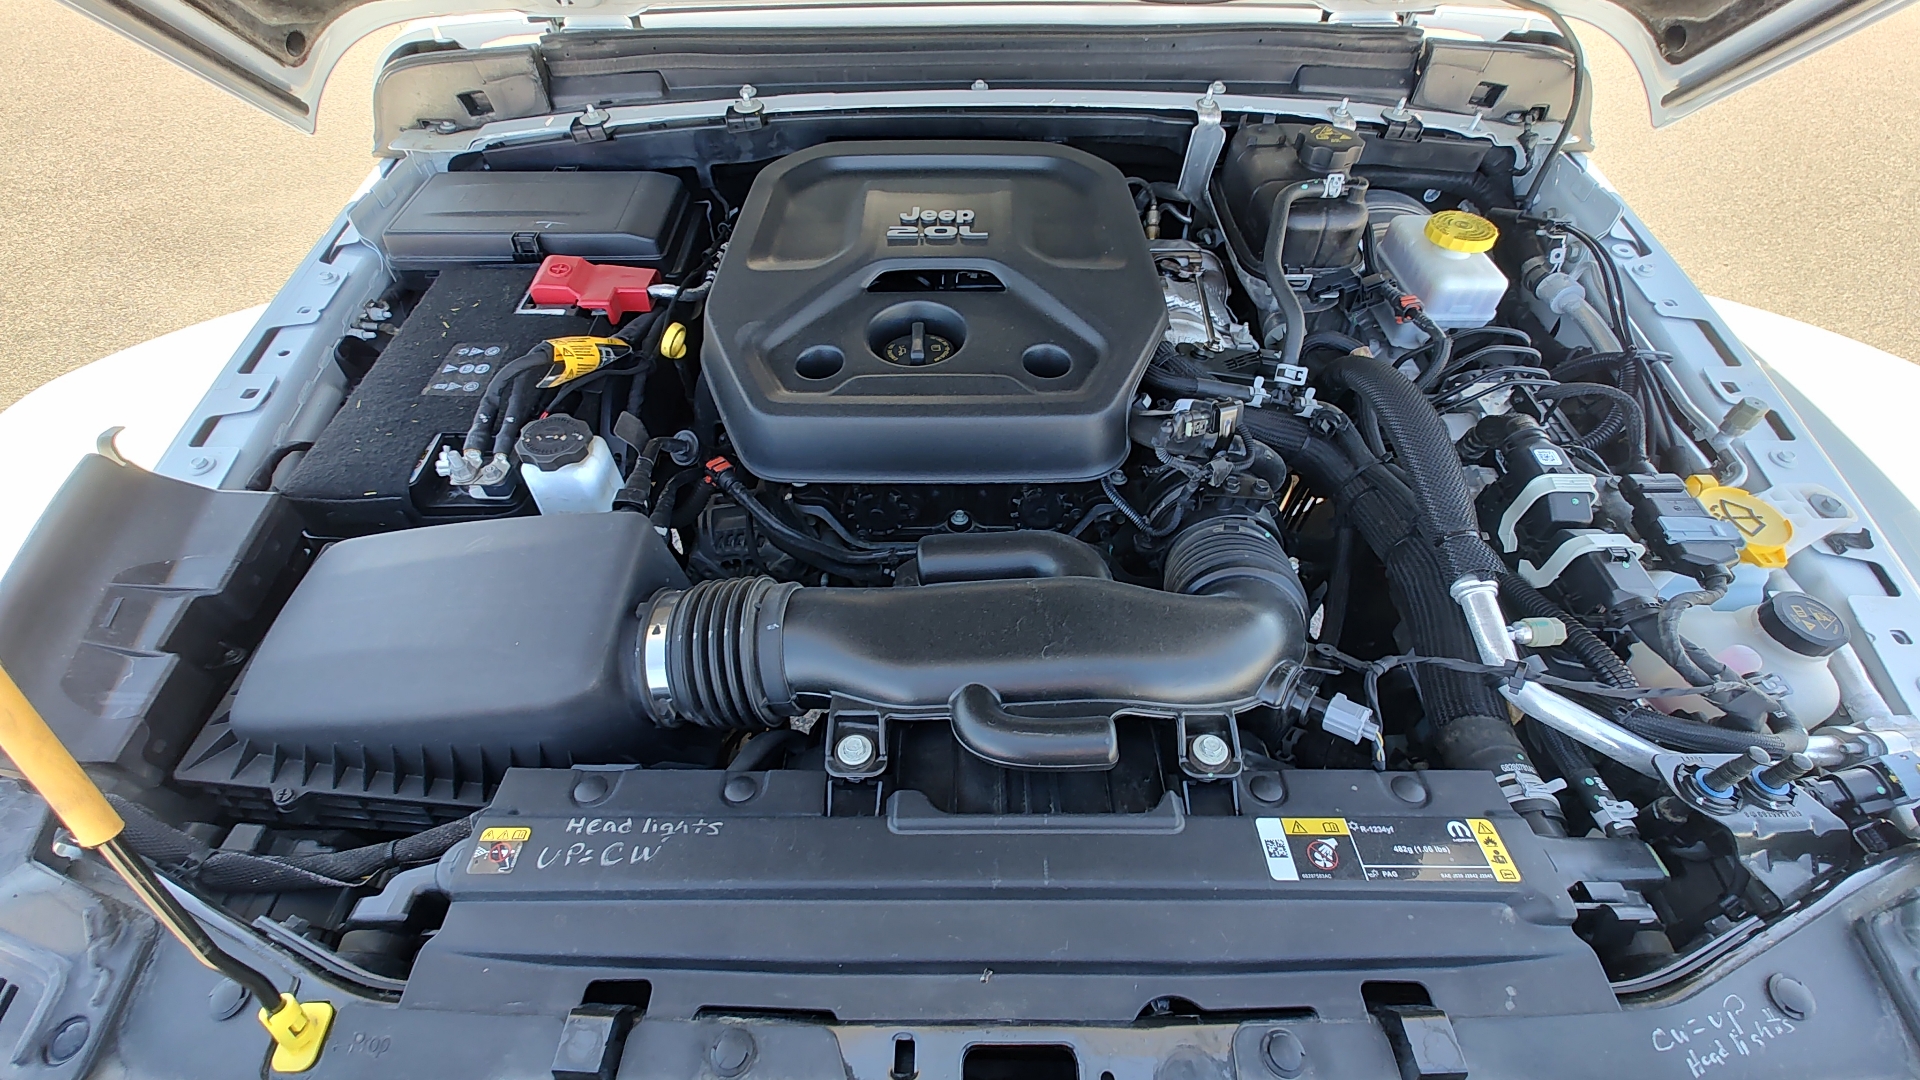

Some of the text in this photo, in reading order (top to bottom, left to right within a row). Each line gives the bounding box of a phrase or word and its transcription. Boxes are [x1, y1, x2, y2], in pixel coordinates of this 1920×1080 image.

[899, 206, 975, 224] Jeep
[886, 225, 989, 240] 2.0L
[567, 816, 724, 835] Head lights
[1360, 825, 1395, 835] R-1234yf
[1393, 845, 1413, 855] 482g
